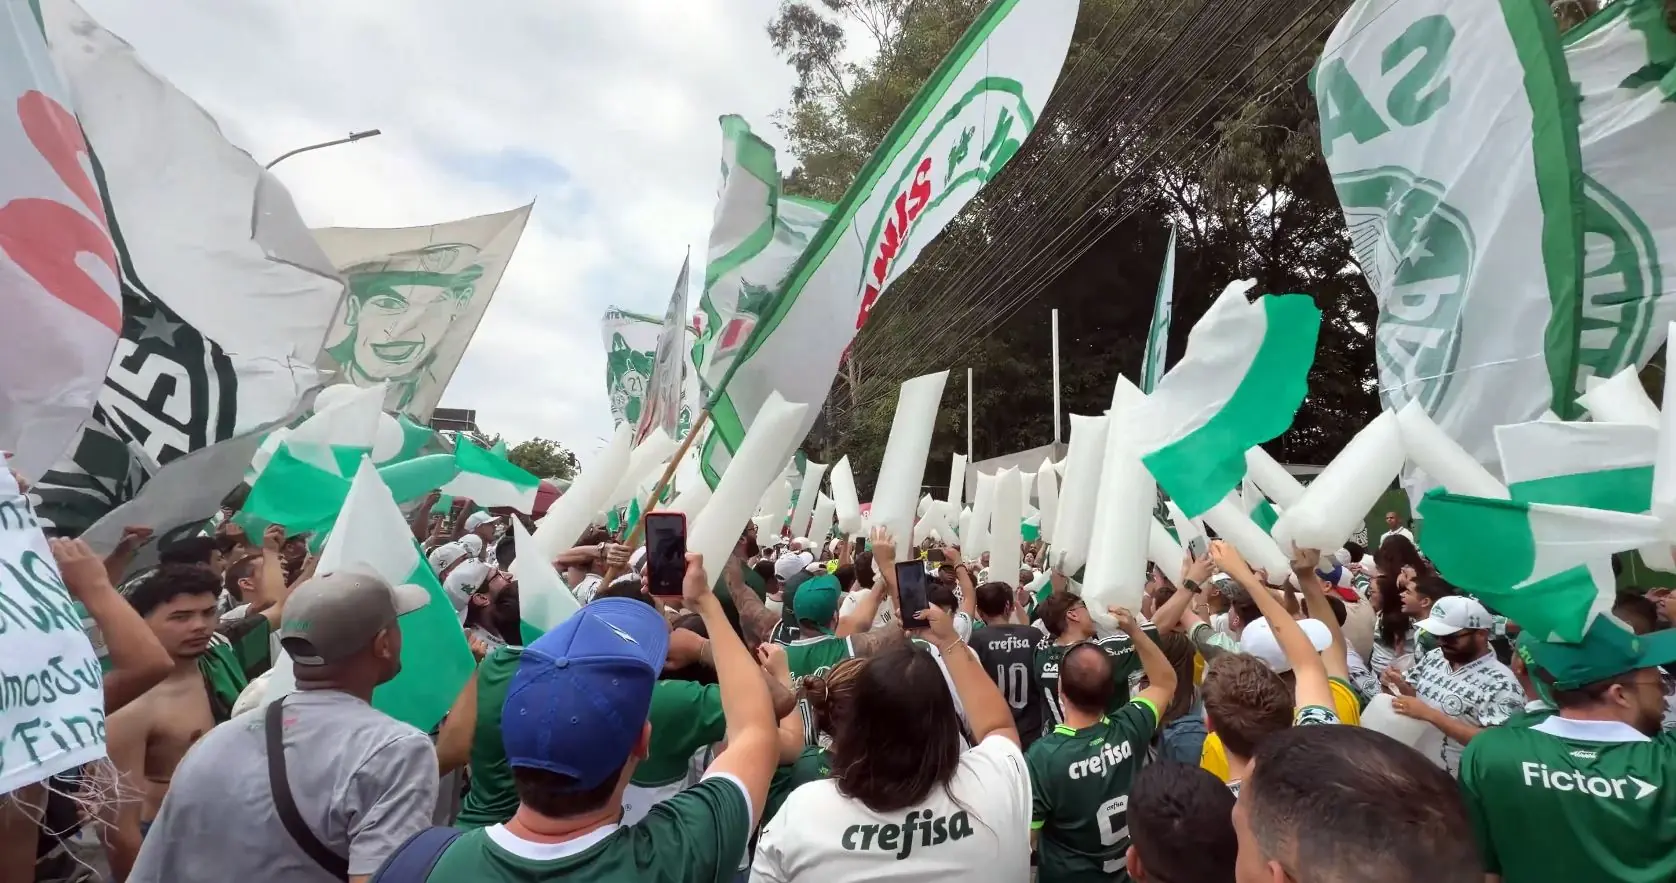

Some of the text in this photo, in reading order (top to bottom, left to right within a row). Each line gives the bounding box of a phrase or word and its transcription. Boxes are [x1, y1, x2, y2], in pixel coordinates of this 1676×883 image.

[988, 636, 1030, 653] crefisa
[997, 662, 1028, 709] 10
[1068, 739, 1132, 780] crefisa
[1521, 761, 1628, 799] Fictor
[841, 808, 974, 861] crefisa
